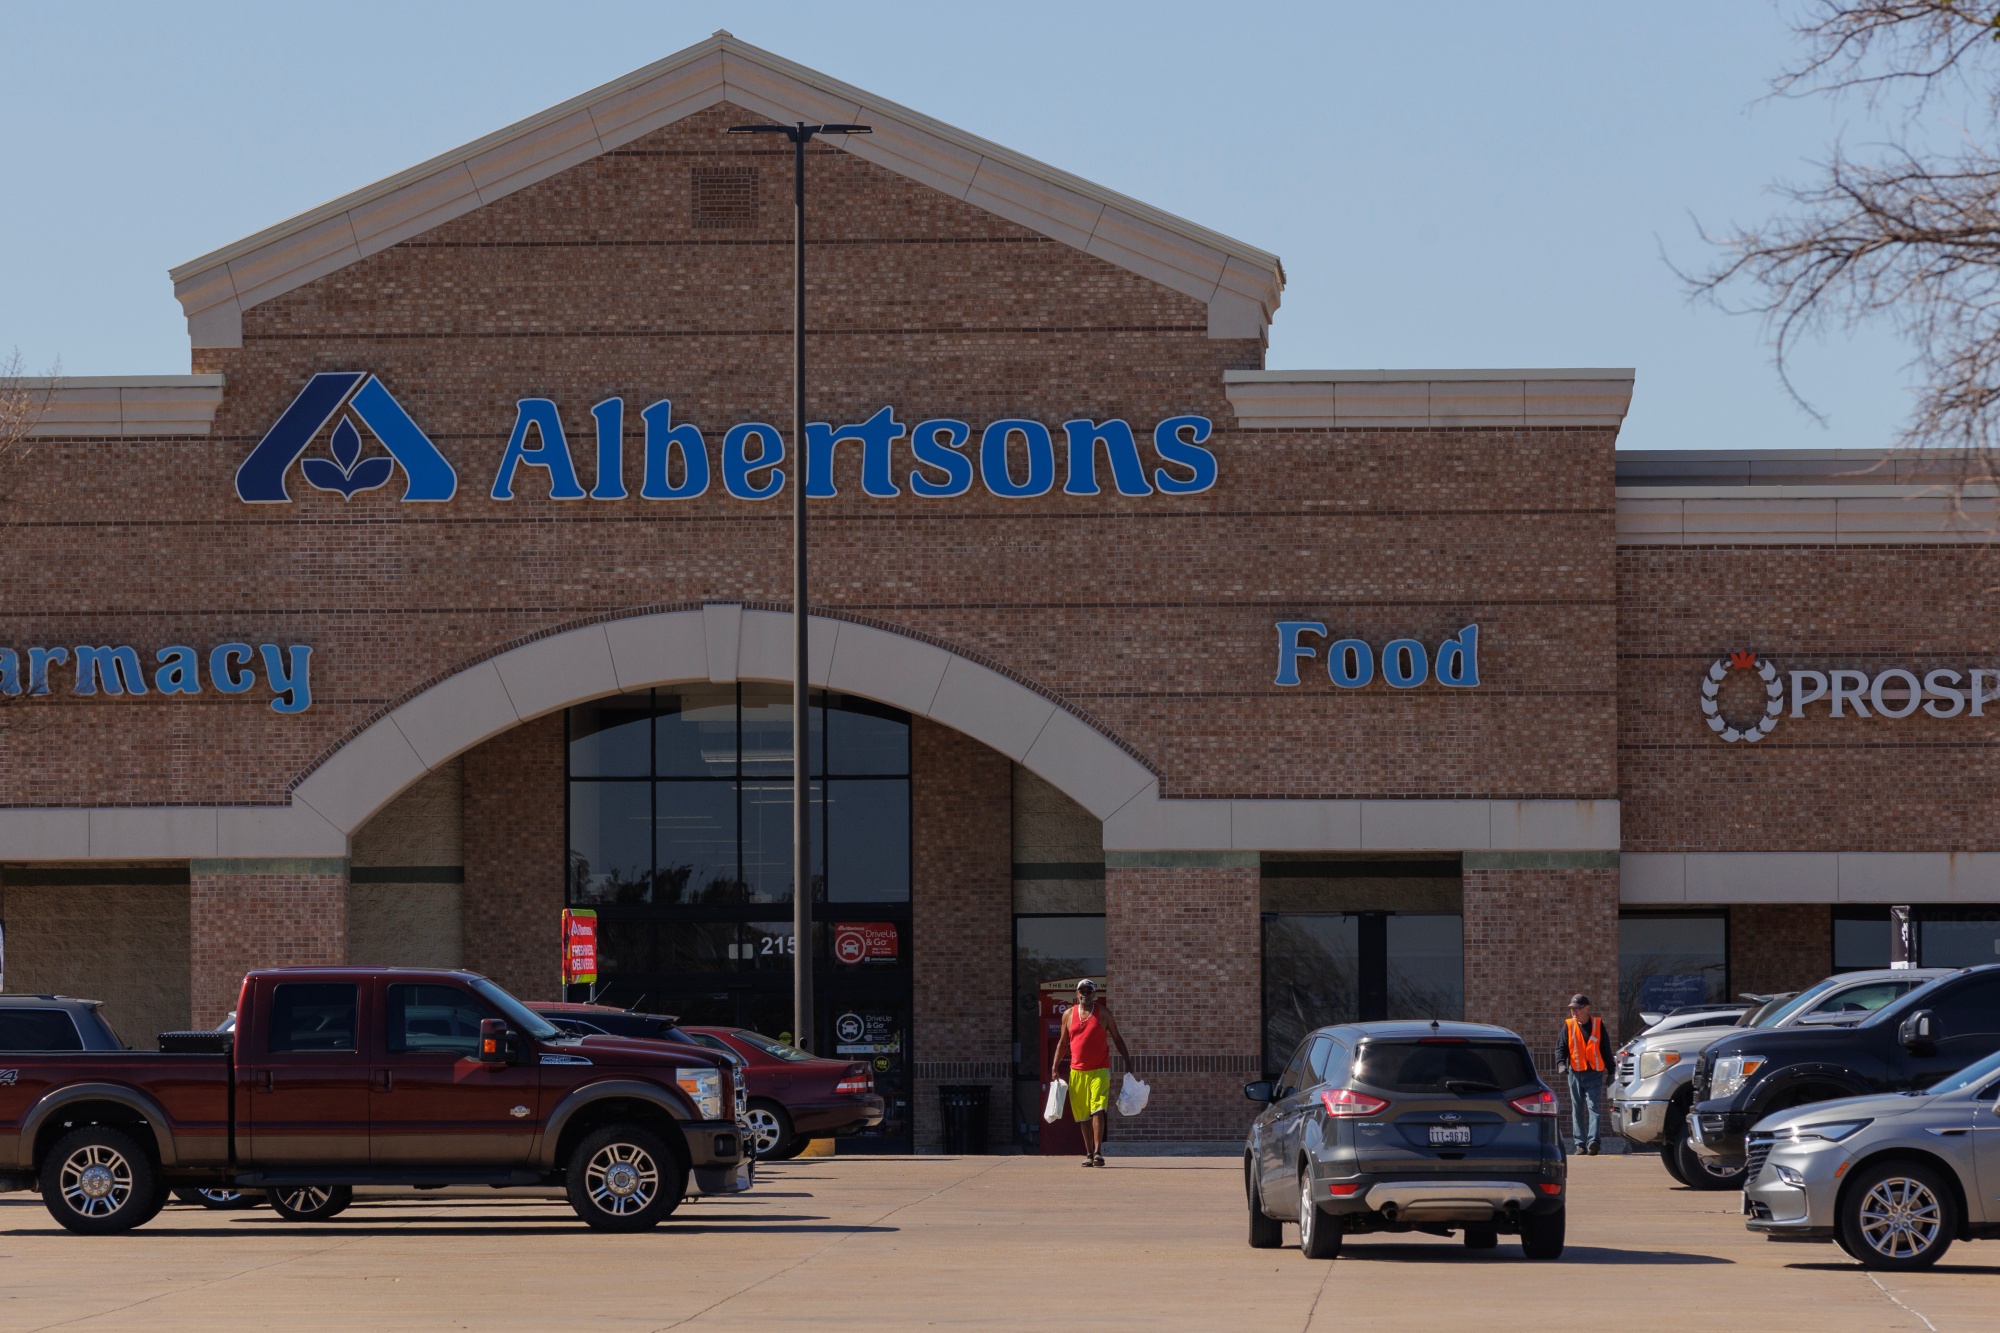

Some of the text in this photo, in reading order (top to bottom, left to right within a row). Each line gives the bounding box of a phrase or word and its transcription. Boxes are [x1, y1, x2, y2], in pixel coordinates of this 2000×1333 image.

[490, 397, 1218, 500] Albertsons
[1274, 621, 1480, 688] Food
[1789, 669, 2000, 719] PROSP
[865, 930, 897, 940] DriveUp
[866, 938, 873, 946] &
[761, 936, 795, 955] 215
[865, 1014, 892, 1023] DriveUp
[866, 1021, 872, 1029] &
